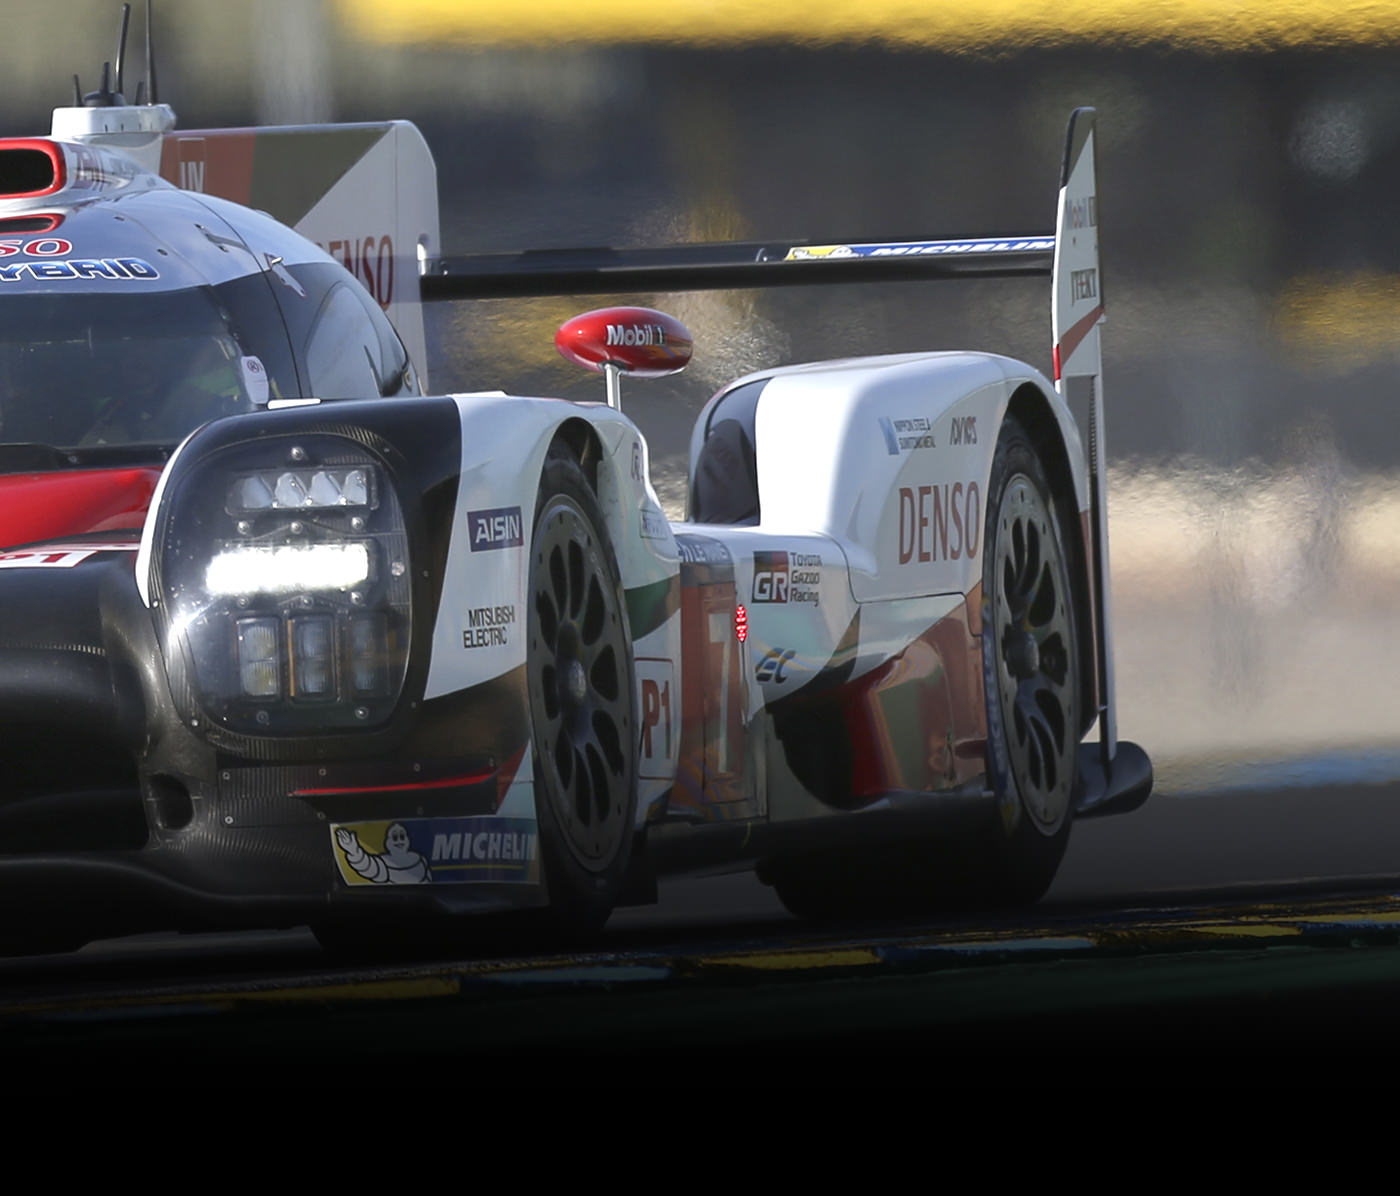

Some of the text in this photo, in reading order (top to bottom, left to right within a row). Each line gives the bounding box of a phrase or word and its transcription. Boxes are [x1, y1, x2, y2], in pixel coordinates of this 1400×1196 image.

[870, 240, 1056, 257] MICHELIN
[606, 324, 653, 346] Mobil
[475, 514, 521, 544] AISIN
[899, 481, 981, 566] DENSO
[753, 571, 788, 601] GR
[790, 587, 820, 607] Racing
[468, 605, 516, 628] MITSUBISHI
[463, 627, 508, 649] ELECTRIC
[642, 679, 671, 759] P1
[431, 831, 538, 861] MICHELIN
